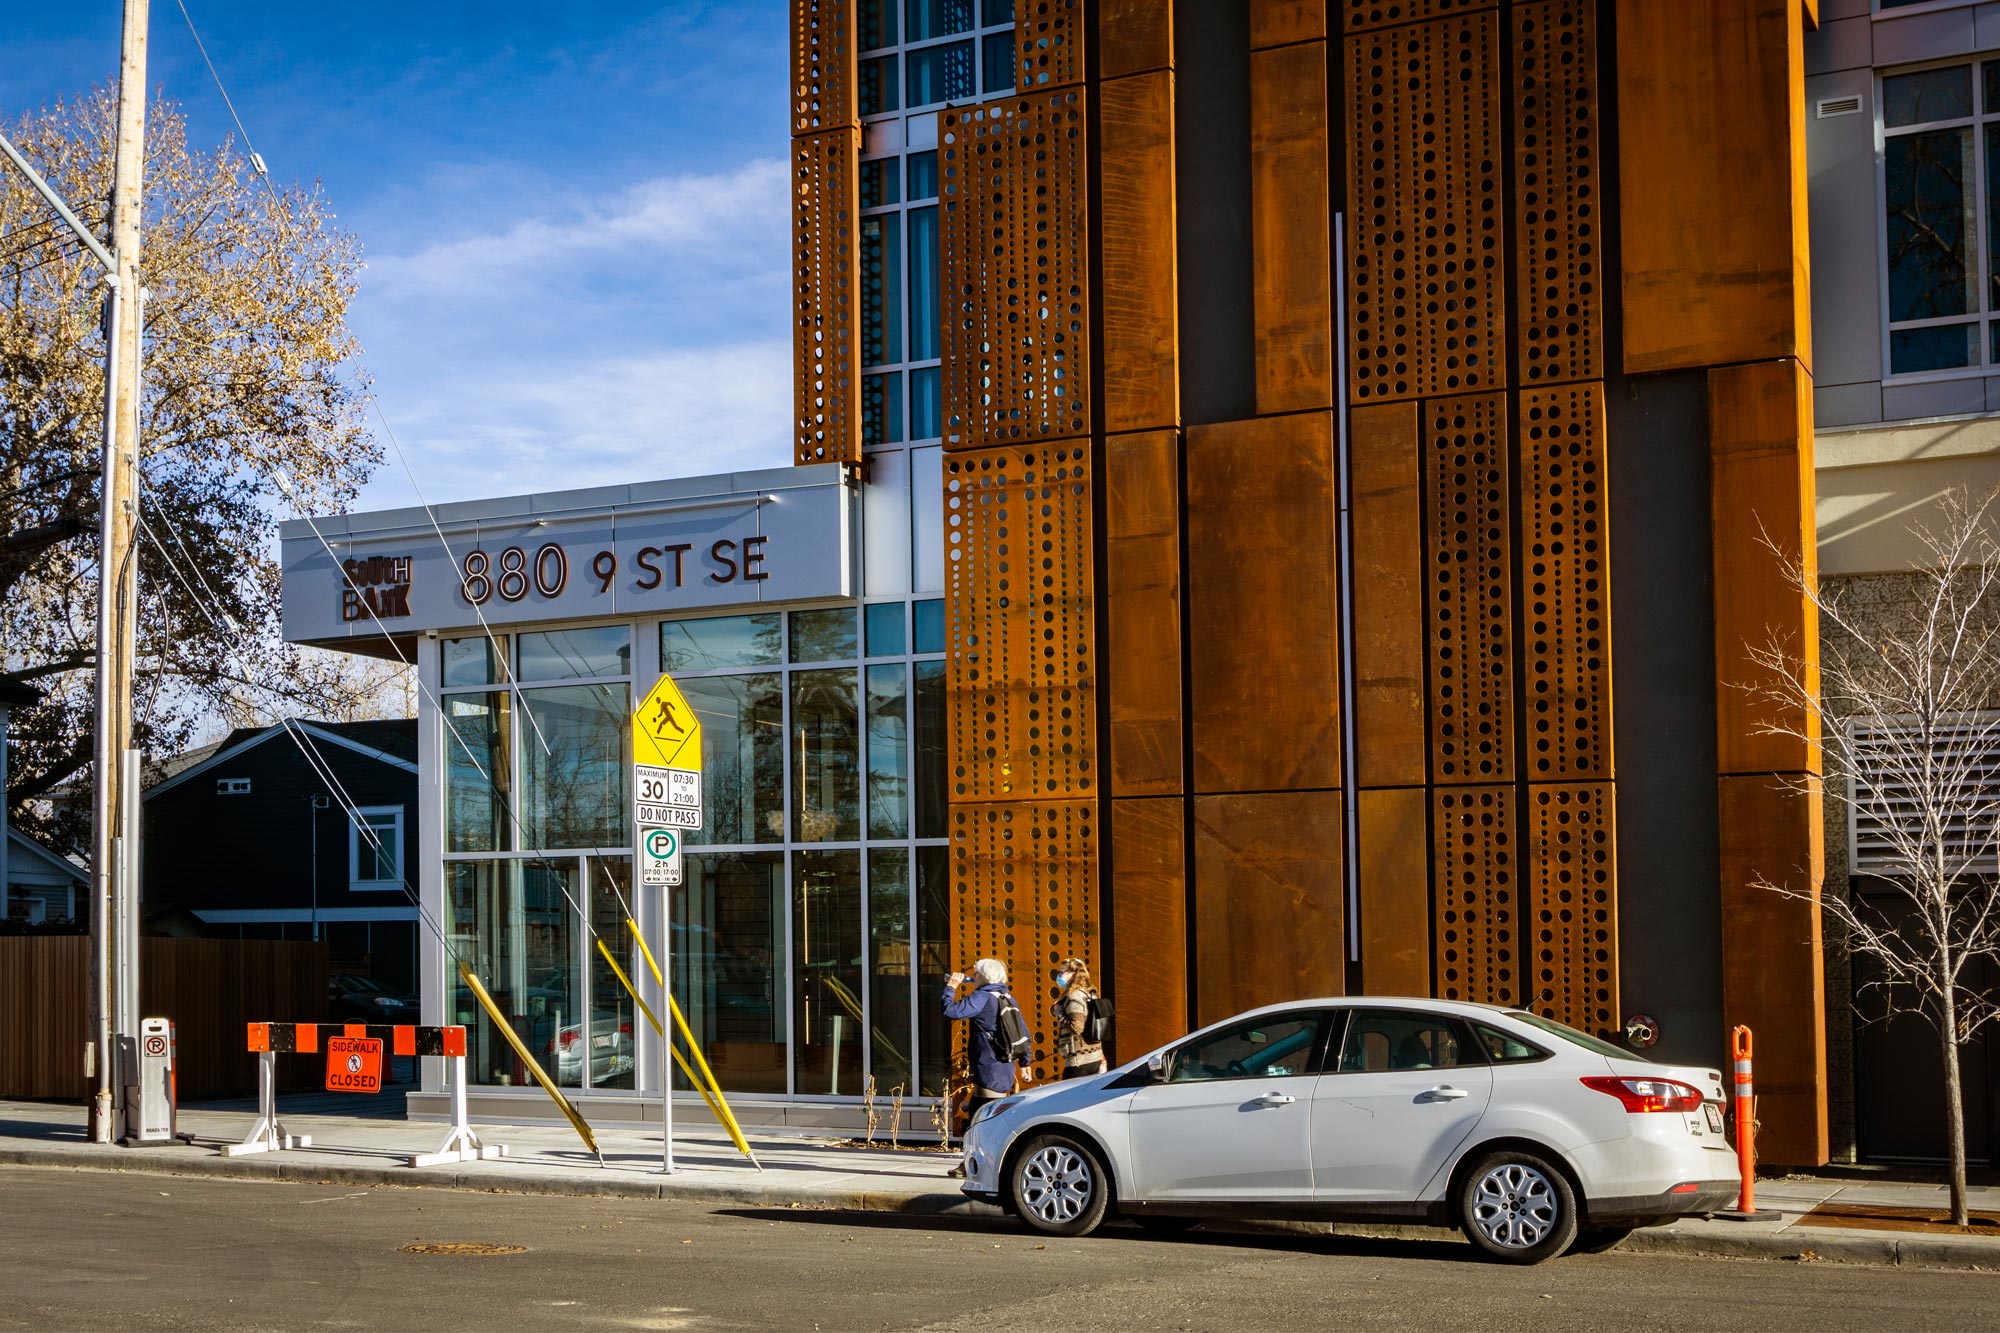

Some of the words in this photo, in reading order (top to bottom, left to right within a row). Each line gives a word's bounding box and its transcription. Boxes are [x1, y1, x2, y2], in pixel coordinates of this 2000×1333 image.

[461, 542, 568, 605] 880
[593, 550, 618, 593] 9
[636, 543, 694, 589] ST
[710, 536, 770, 584] SE
[637, 768, 668, 779] MAXIMUM
[673, 774, 694, 785] 07:30
[642, 779, 664, 800] 30
[673, 792, 694, 804] 21:00
[640, 807, 653, 821] DO
[655, 808, 673, 822] NOT
[675, 810, 696, 824] PASS
[655, 836, 669, 853] P
[332, 1041, 378, 1053] SIDEWALK
[330, 1074, 376, 1087] CLOSED
